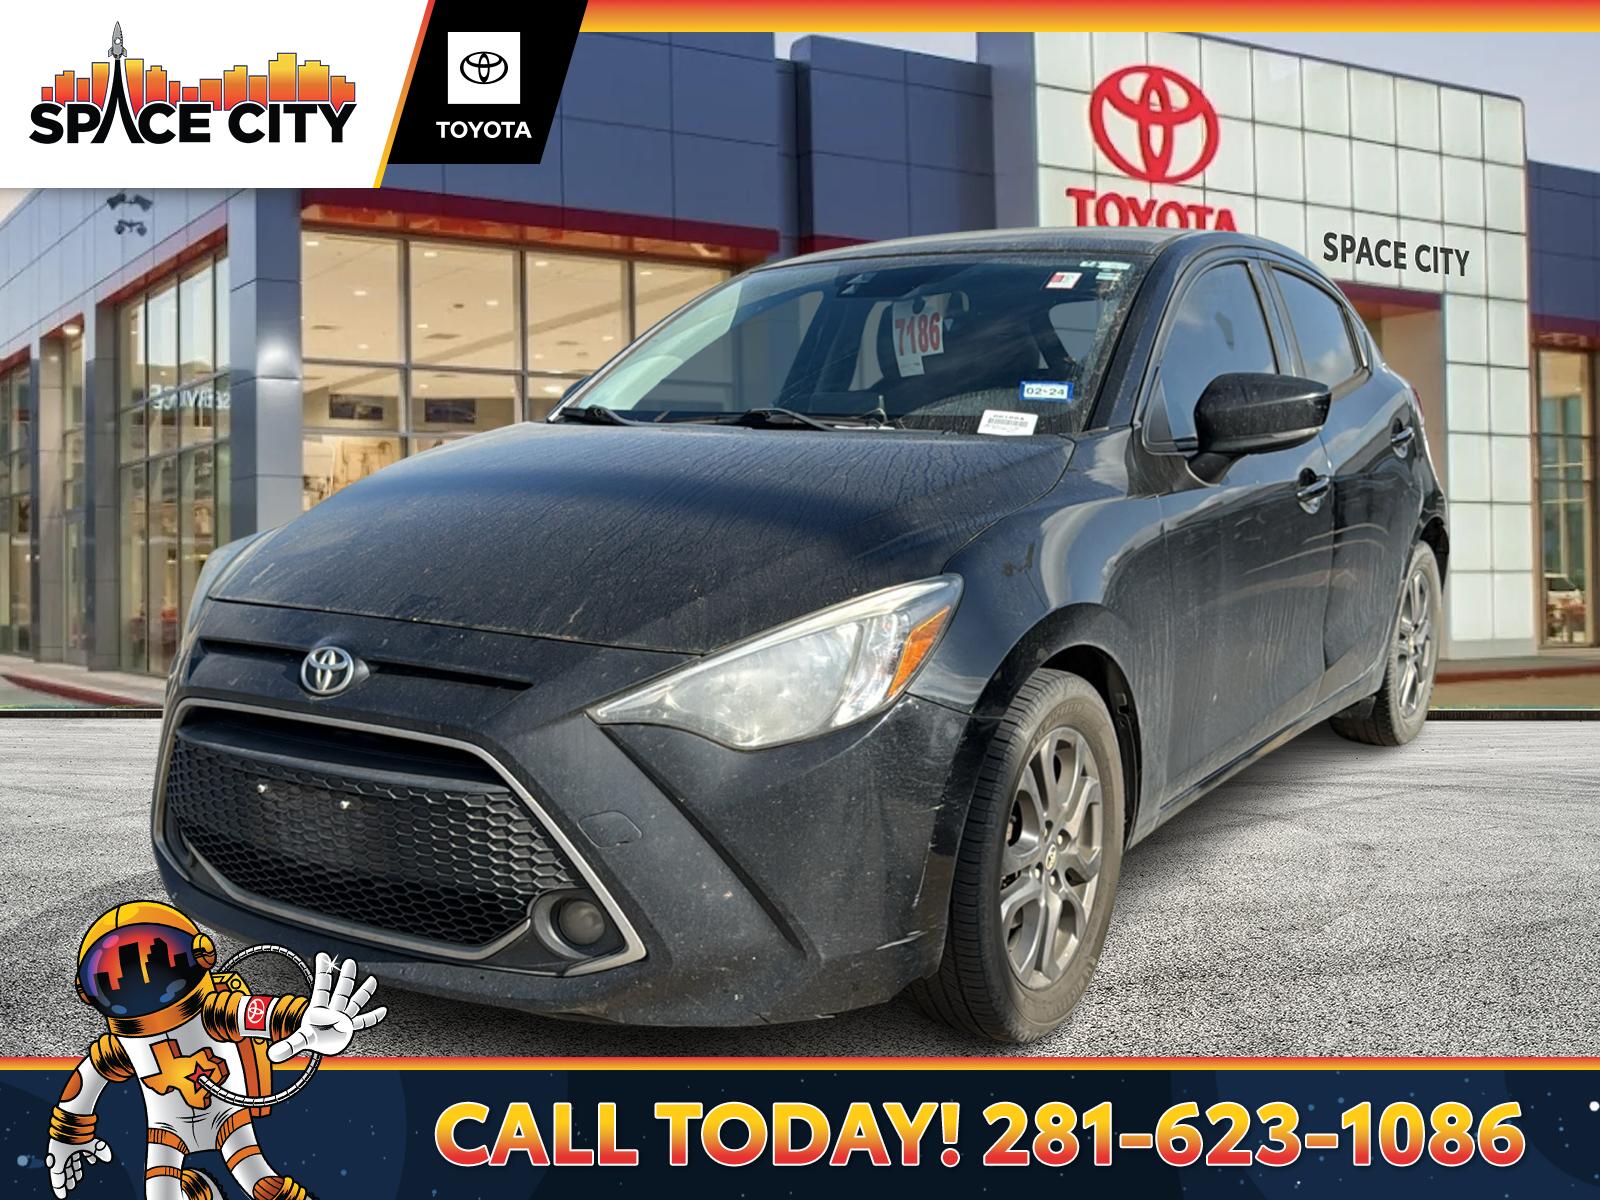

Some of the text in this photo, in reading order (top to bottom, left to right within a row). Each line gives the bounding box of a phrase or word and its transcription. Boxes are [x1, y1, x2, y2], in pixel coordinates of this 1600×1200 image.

[1066, 188, 1237, 232] TOYOTA
[1323, 231, 1470, 277] SPACE CITY
[895, 312, 942, 356] 7186
